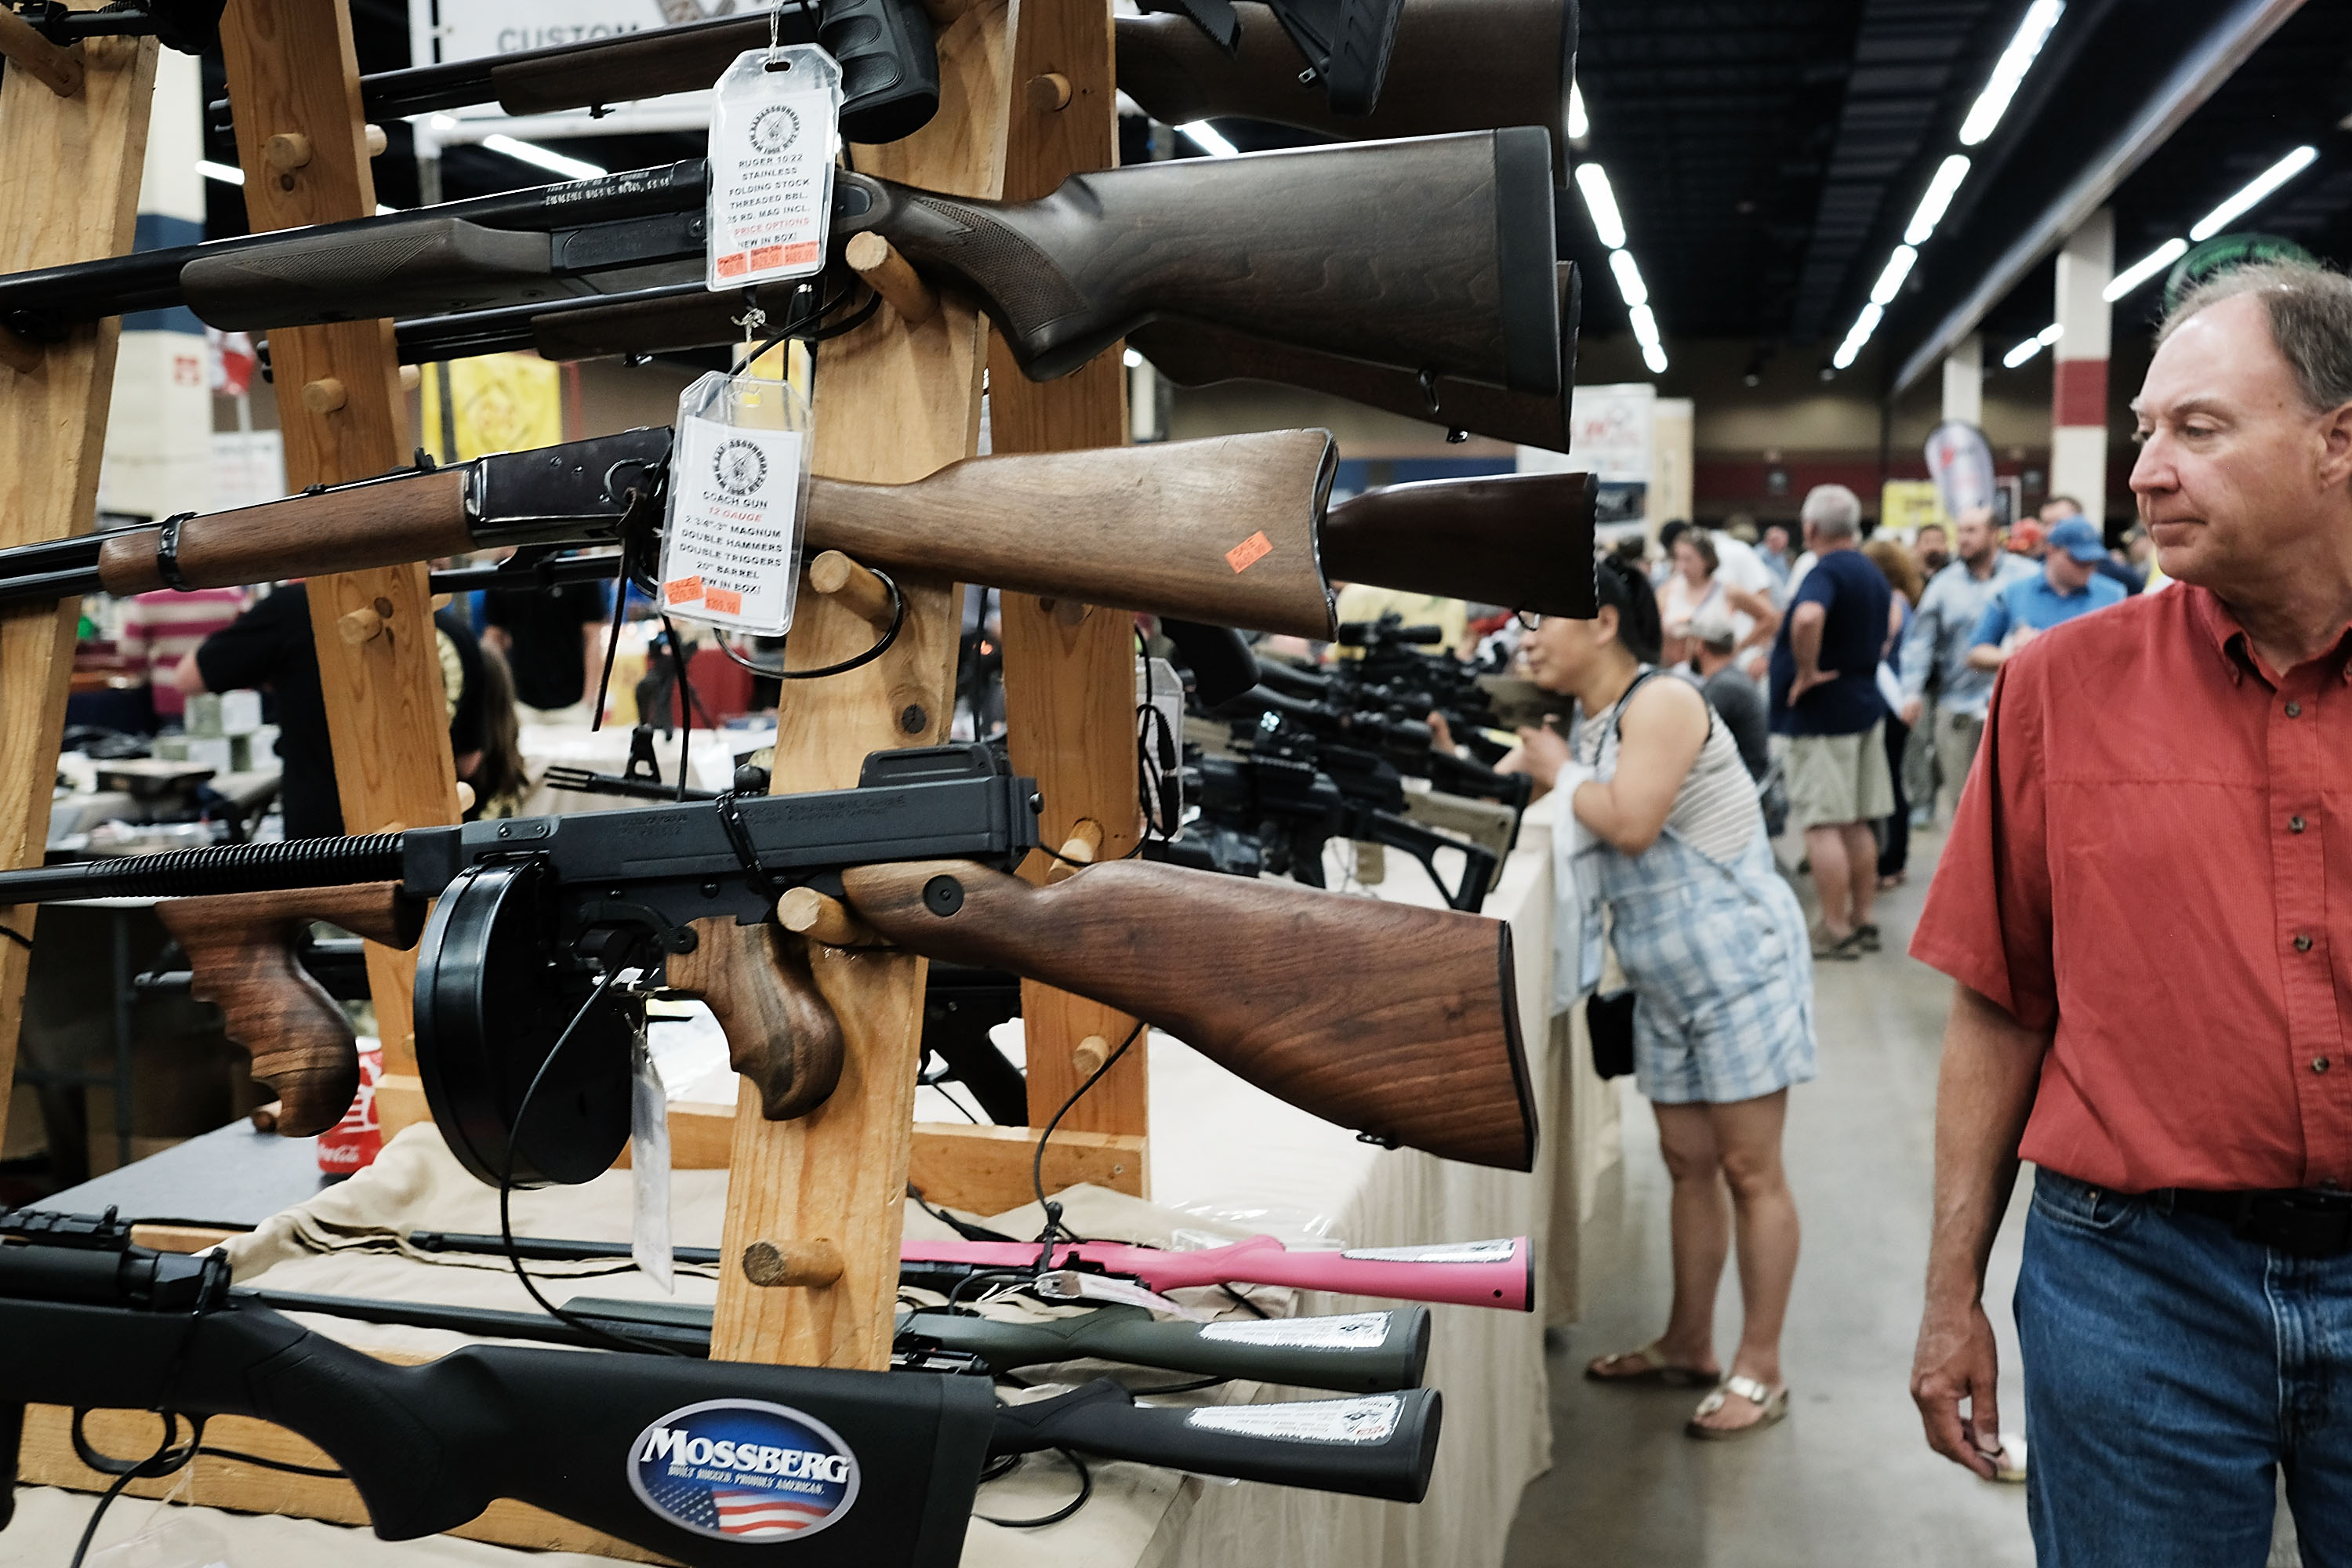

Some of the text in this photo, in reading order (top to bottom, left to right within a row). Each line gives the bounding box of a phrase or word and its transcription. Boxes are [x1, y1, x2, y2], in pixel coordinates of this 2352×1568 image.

[497, 23, 641, 53] CUSTO
[739, 158, 773, 168] RUGER
[742, 167, 797, 180] STAINLESS
[729, 178, 810, 196] FOLDING STOCK
[730, 194, 782, 209] THREADED
[758, 208, 780, 218] MAG
[735, 217, 810, 236] PRICE OPTIONS
[738, 238, 759, 249] NEW
[702, 491, 768, 510] COACH GUN
[709, 506, 764, 523] 12 GAUGE
[731, 525, 782, 539] MAGNUM
[681, 528, 783, 554] DOUBLE HAMMERS
[680, 543, 783, 567] DOUBLE TRIGGERS
[717, 565, 760, 579] BARREL
[720, 579, 731, 590] IN
[639, 1426, 850, 1484] MOSSBERG
